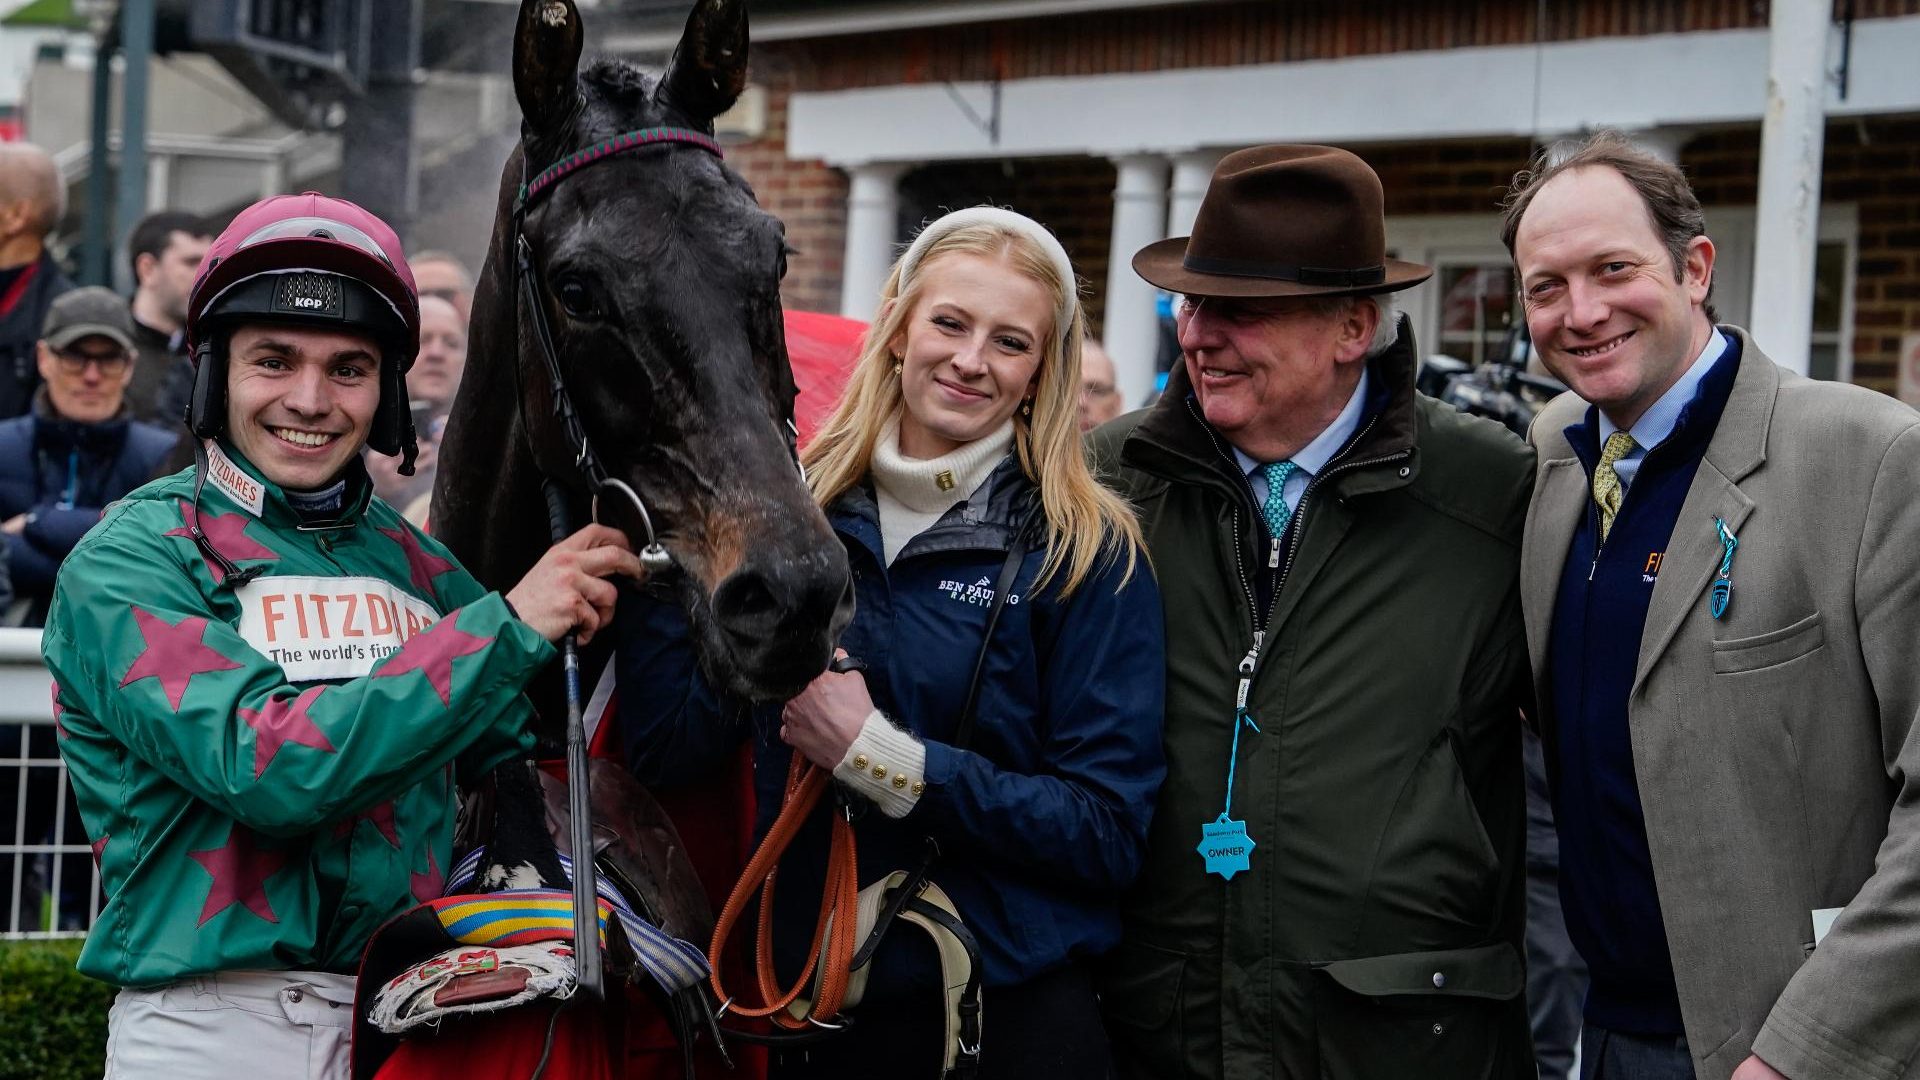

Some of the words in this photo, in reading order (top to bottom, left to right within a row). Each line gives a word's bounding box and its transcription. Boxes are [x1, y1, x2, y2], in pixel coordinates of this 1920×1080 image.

[938, 580, 964, 593] BEN
[269, 647, 303, 664] The
[308, 644, 365, 661] world's
[369, 643, 404, 659] fin
[1208, 846, 1245, 858] OWNER
